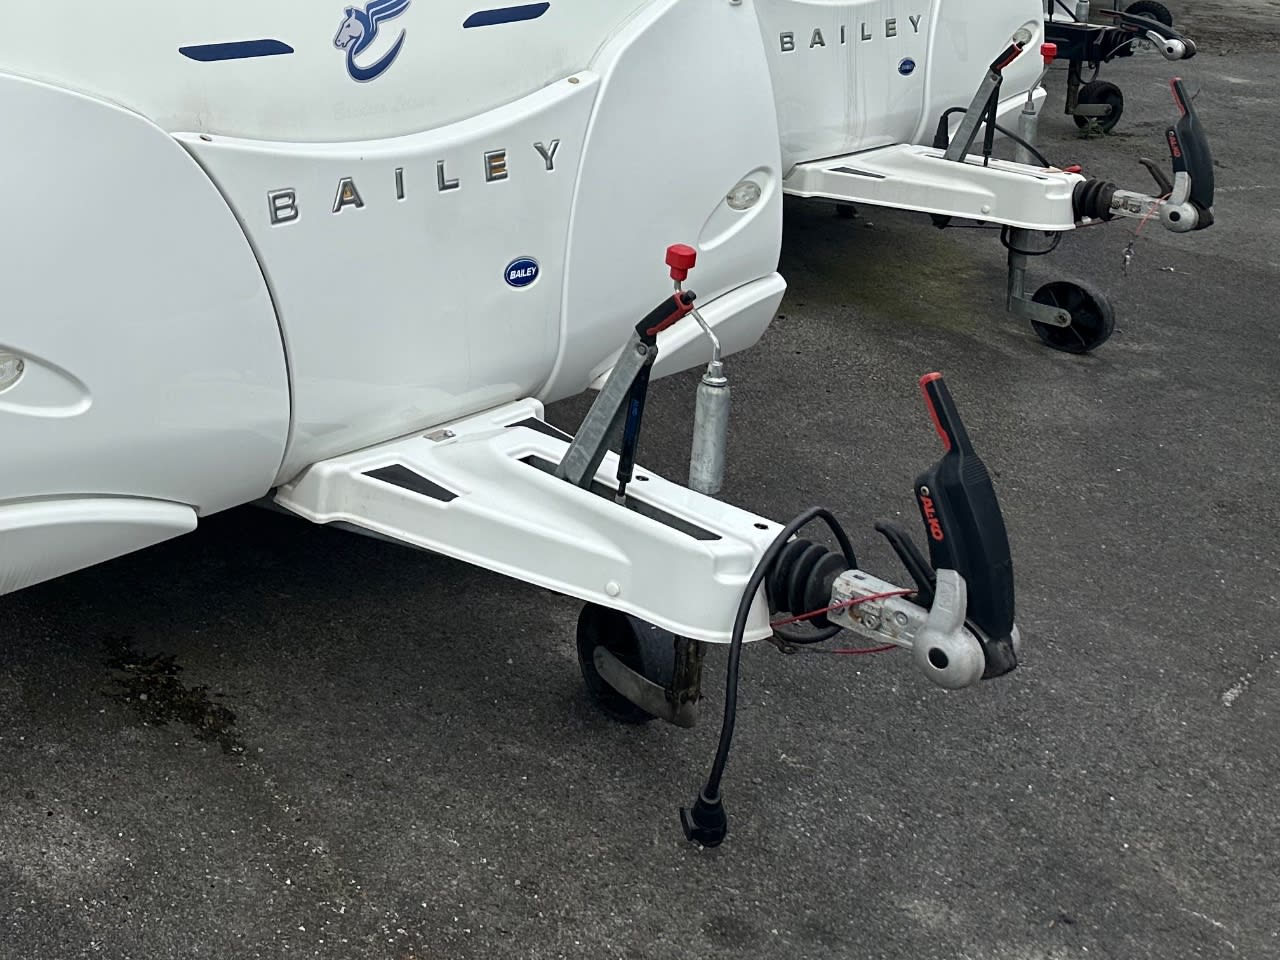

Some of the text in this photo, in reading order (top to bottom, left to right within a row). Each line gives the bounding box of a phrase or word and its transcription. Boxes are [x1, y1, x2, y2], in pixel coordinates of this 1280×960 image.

[779, 14, 922, 52] BAILEY
[267, 138, 561, 226] BAILEY
[509, 266, 537, 280] BAILEY
